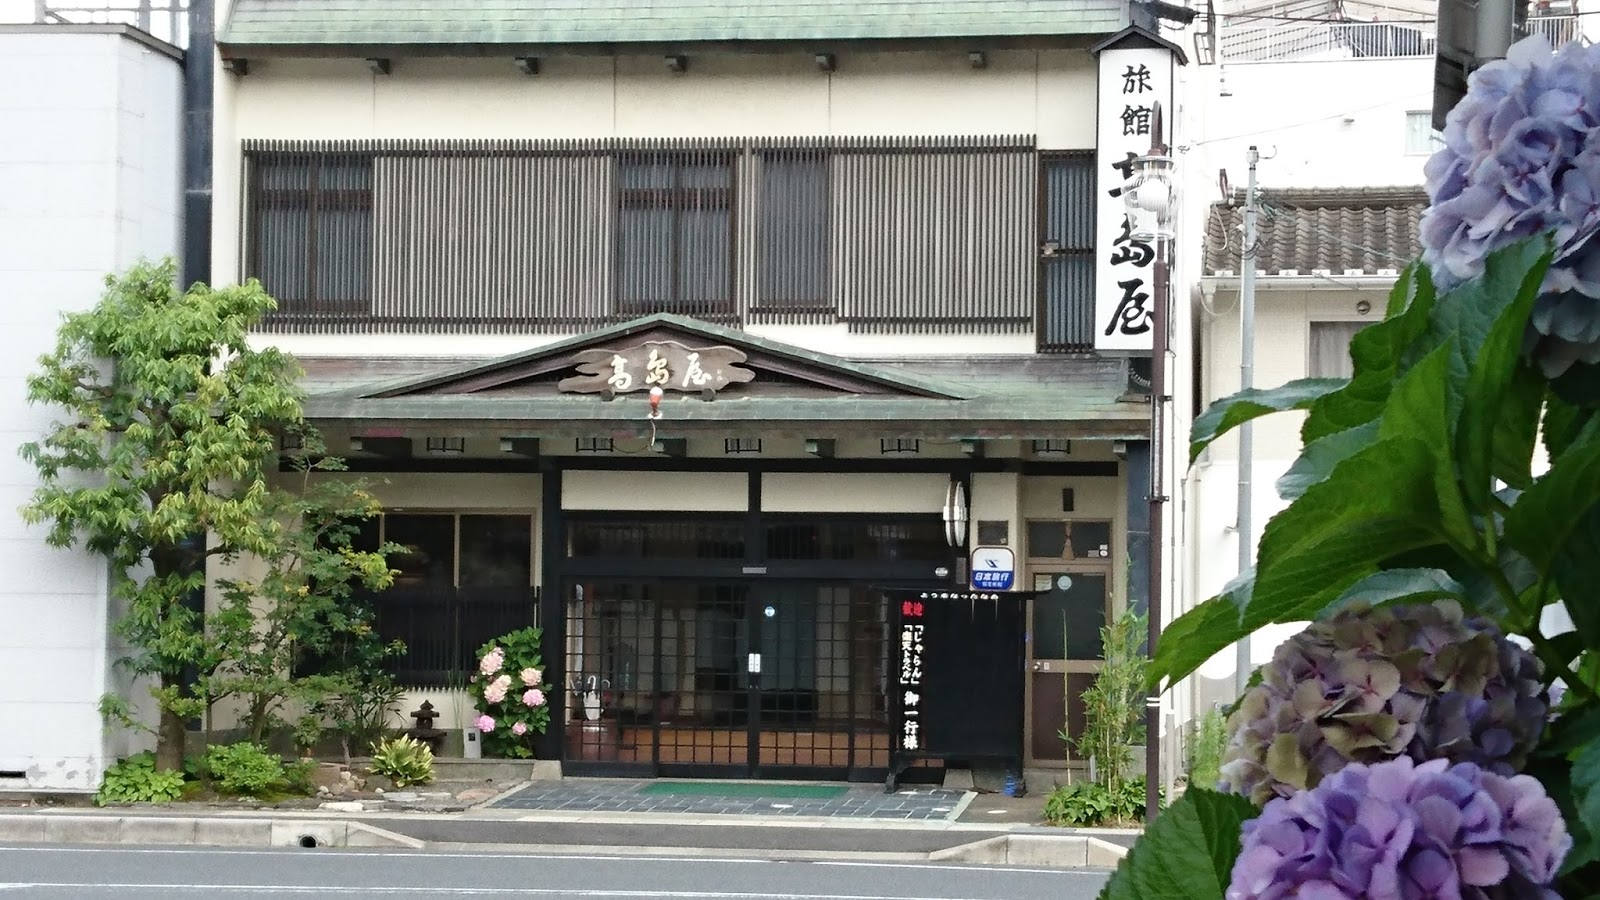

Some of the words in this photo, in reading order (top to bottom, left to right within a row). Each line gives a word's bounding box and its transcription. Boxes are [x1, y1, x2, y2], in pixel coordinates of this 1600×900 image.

[1120, 63, 1153, 136] 旅館
[608, 349, 712, 389] 高島屋
